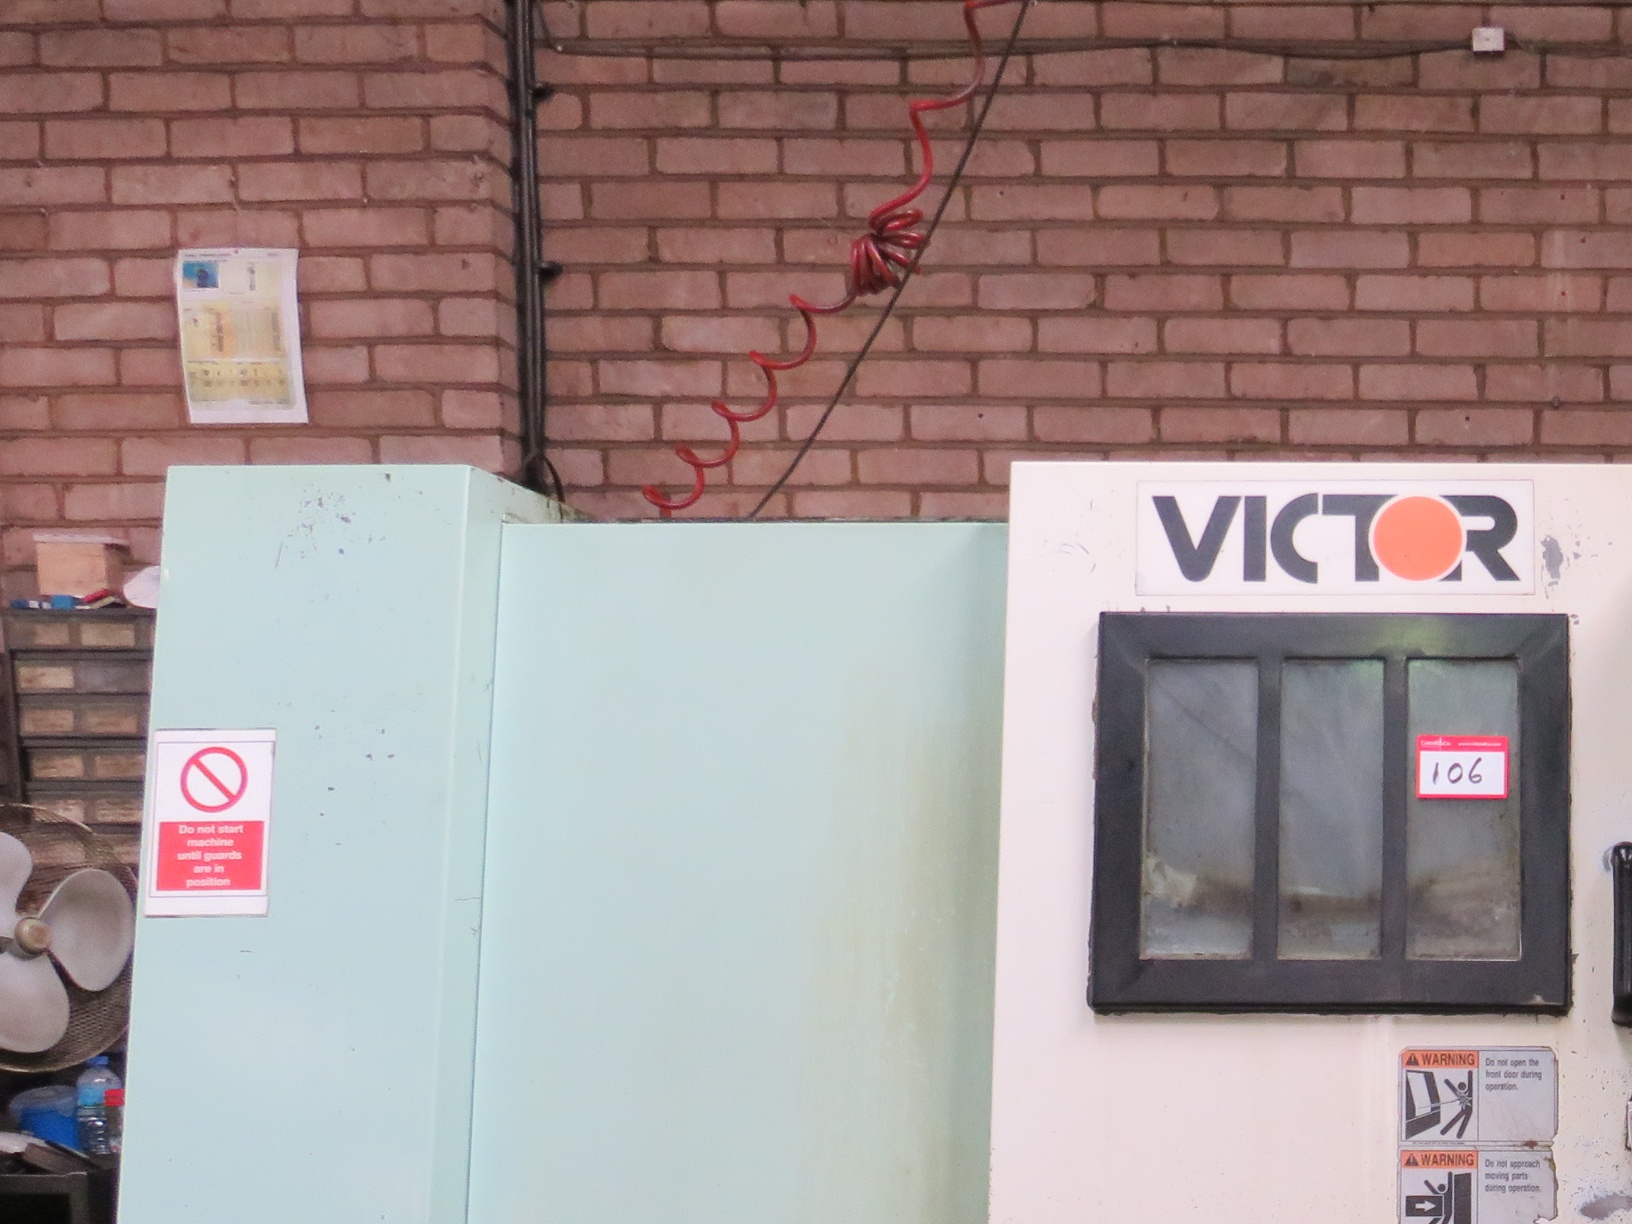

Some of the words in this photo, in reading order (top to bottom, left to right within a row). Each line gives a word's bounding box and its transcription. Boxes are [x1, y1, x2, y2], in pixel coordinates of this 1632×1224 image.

[1152, 493, 1521, 584] VICTOR
[1432, 757, 1482, 785] 106
[178, 824, 194, 834] Do
[197, 824, 215, 834] not
[218, 824, 244, 834] start
[187, 838, 234, 847] machine
[177, 850, 201, 860] until
[204, 850, 242, 862] guards
[193, 864, 211, 873] are
[214, 863, 224, 873] in
[186, 877, 230, 888] position
[1422, 1053, 1475, 1065] WARNING
[1485, 1058, 1495, 1067] Do
[1497, 1058, 1508, 1067] not
[1510, 1059, 1526, 1069] open
[1529, 1058, 1540, 1067] the
[1485, 1070, 1501, 1079] front
[1504, 1070, 1519, 1079] door
[1521, 1070, 1542, 1081] during
[1485, 1082, 1519, 1092] operation.
[1421, 1153, 1474, 1166] WARNING
[1485, 1159, 1494, 1168] Do
[1497, 1159, 1507, 1168] not
[1510, 1159, 1540, 1171] approach
[1485, 1172, 1509, 1182] moving
[1511, 1172, 1528, 1182] parts
[1485, 1184, 1506, 1194] during
[1508, 1184, 1541, 1194] operation.
